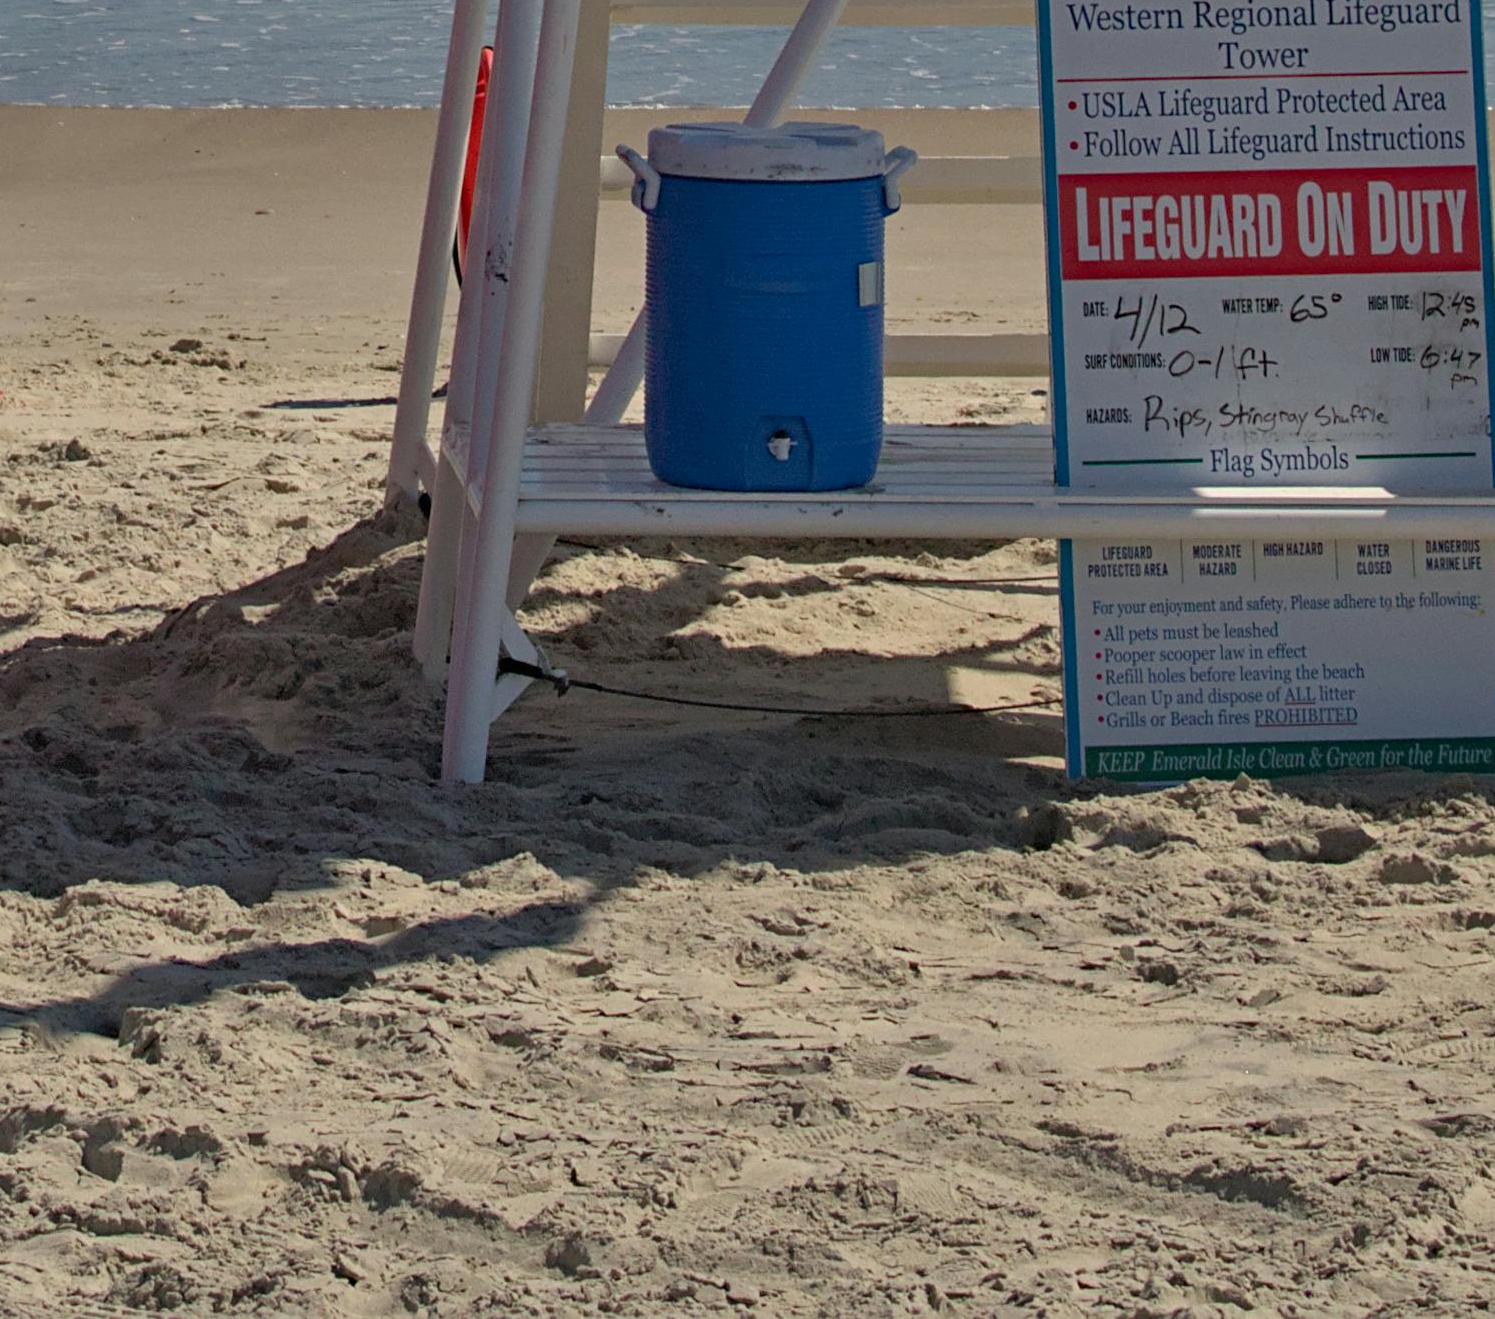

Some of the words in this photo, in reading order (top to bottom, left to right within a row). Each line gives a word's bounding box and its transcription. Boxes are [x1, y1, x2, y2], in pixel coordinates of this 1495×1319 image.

[1067, 0, 1185, 32] Western
[1218, 43, 1309, 71] Tower
[1082, 92, 1153, 119] USLA
[1158, 89, 1270, 123] Lifeguard
[1275, 86, 1387, 115] Protected
[1391, 85, 1447, 112] Area
[1083, 131, 1163, 158] Follow
[1168, 128, 1200, 156] All
[1208, 125, 1319, 160] Lifeguard
[1325, 123, 1466, 153] Instructions
[1083, 302, 1109, 317] DATE:
[1222, 298, 1254, 314] WATER
[1256, 298, 1284, 313] TEMP:
[1290, 293, 1342, 323] 65°
[1368, 296, 1389, 311] HIGH
[1391, 295, 1414, 310] TIDE:
[1114, 294, 1202, 350] 4/12
[1460, 318, 1480, 333] pm
[1085, 355, 1108, 370] SURF
[1110, 353, 1167, 369] CONDITIONS:
[1370, 348, 1390, 363] LOW
[1393, 347, 1416, 362] TIDE:
[1419, 345, 1482, 369] 6:47
[1449, 375, 1479, 390] pm
[1086, 408, 1133, 425] HAZARDS:
[1144, 394, 1212, 438] Rips,
[1219, 403, 1309, 436] Stingray
[1315, 405, 1389, 427] Shuffle
[1210, 449, 1256, 477] Flag
[1260, 445, 1350, 476] Symbols
[1102, 546, 1153, 561] LIFEGUARD
[1192, 544, 1242, 559] MODERATE
[1263, 542, 1283, 557] HIGH
[1286, 541, 1324, 556] HAZARD
[1357, 543, 1390, 558] WATER
[1425, 539, 1481, 554] DANGEROUS
[1088, 563, 1141, 578] PROTECTED
[1144, 563, 1169, 577] AREA
[1199, 562, 1237, 576] HAZARD
[1356, 561, 1392, 576] CLOSED
[1425, 557, 1460, 571] MARINE
[1462, 556, 1482, 571] LIFE
[1092, 600, 1115, 615] For
[1117, 603, 1147, 618] your
[1149, 598, 1216, 617] enjoyment
[1219, 596, 1243, 612] and
[1291, 594, 1330, 611] Please
[1333, 593, 1376, 610] adhere
[1379, 596, 1393, 609] to
[1395, 592, 1416, 609] the
[1419, 591, 1481, 610] following:
[1104, 625, 1124, 642] All
[1128, 626, 1159, 645] pets
[1162, 626, 1199, 640] must
[1202, 623, 1221, 639] be
[1223, 621, 1279, 639] leashed
[1104, 648, 1156, 666] Pooper
[1159, 649, 1216, 665] scooper
[1219, 644, 1246, 661] law
[1249, 644, 1263, 660] in
[1267, 643, 1308, 660] effect
[1105, 668, 1144, 685] Refill
[1147, 667, 1186, 683] holes
[1190, 665, 1236, 683] before
[1240, 665, 1292, 683] leaving
[1296, 664, 1319, 681] the
[1322, 663, 1365, 680] beach
[1105, 690, 1146, 707] Clean
[1152, 689, 1173, 708] Up
[1176, 688, 1204, 705] and
[1208, 687, 1264, 707] dispose
[1266, 687, 1282, 703] of
[1285, 687, 1316, 703] ALL
[1319, 685, 1356, 702] litter
[1106, 712, 1146, 729] Grills
[1150, 714, 1166, 727] or
[1171, 711, 1214, 727] Beach
[1218, 709, 1251, 725] fires
[1255, 707, 1358, 725] PROHIBITED
[1097, 751, 1146, 774] KEEP
[1152, 747, 1223, 772] Emerald
[1225, 747, 1255, 770] Isle
[1259, 746, 1305, 769] Clean
[1308, 746, 1324, 768] &
[1326, 745, 1376, 768] Green
[1379, 744, 1404, 769] for
[1409, 743, 1434, 766] the
[1438, 743, 1493, 766] Future
